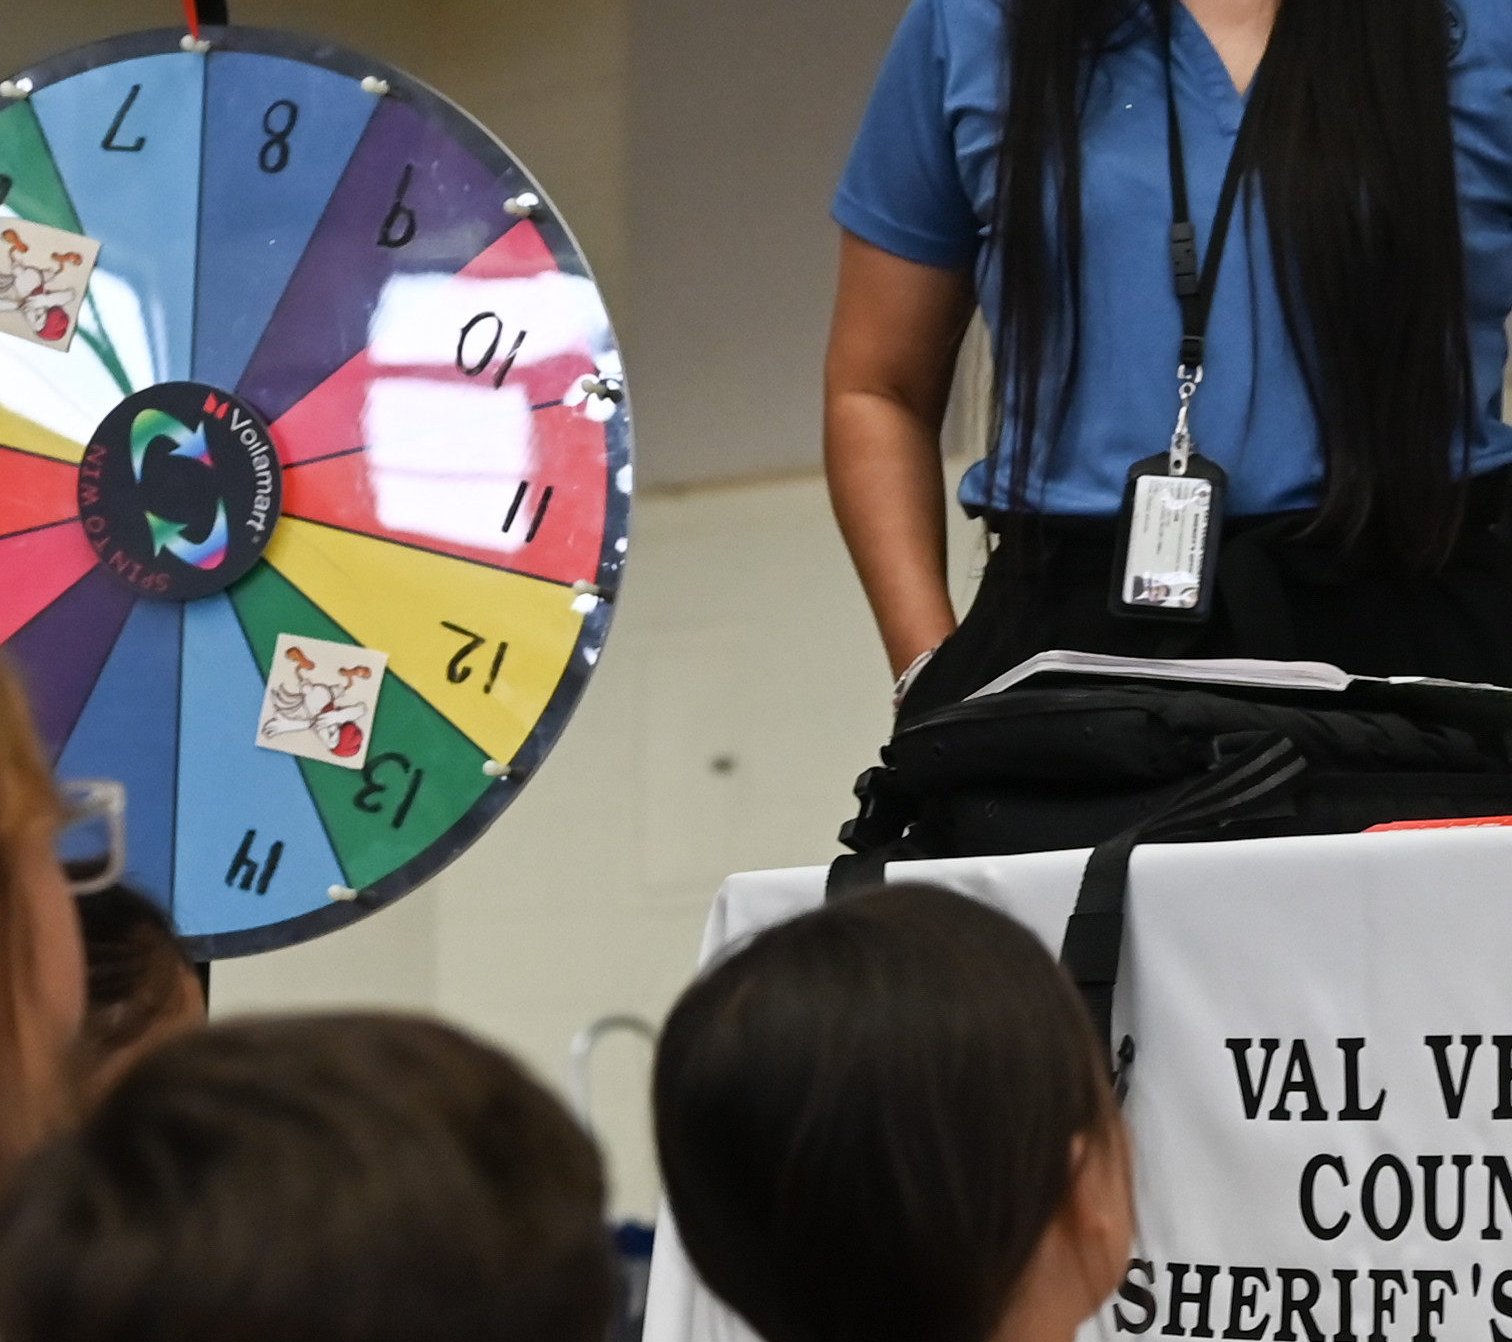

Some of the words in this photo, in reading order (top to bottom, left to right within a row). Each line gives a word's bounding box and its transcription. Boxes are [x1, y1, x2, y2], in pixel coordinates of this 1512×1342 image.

[258, 100, 298, 173] 8
[79, 444, 109, 506] WIN
[229, 407, 274, 532] Voilamart
[85, 515, 112, 554] TO
[107, 550, 171, 592] SPIN
[439, 620, 511, 694] 12
[354, 750, 426, 829] 13
[224, 830, 286, 896] 14
[1225, 1037, 1387, 1121] VAL
